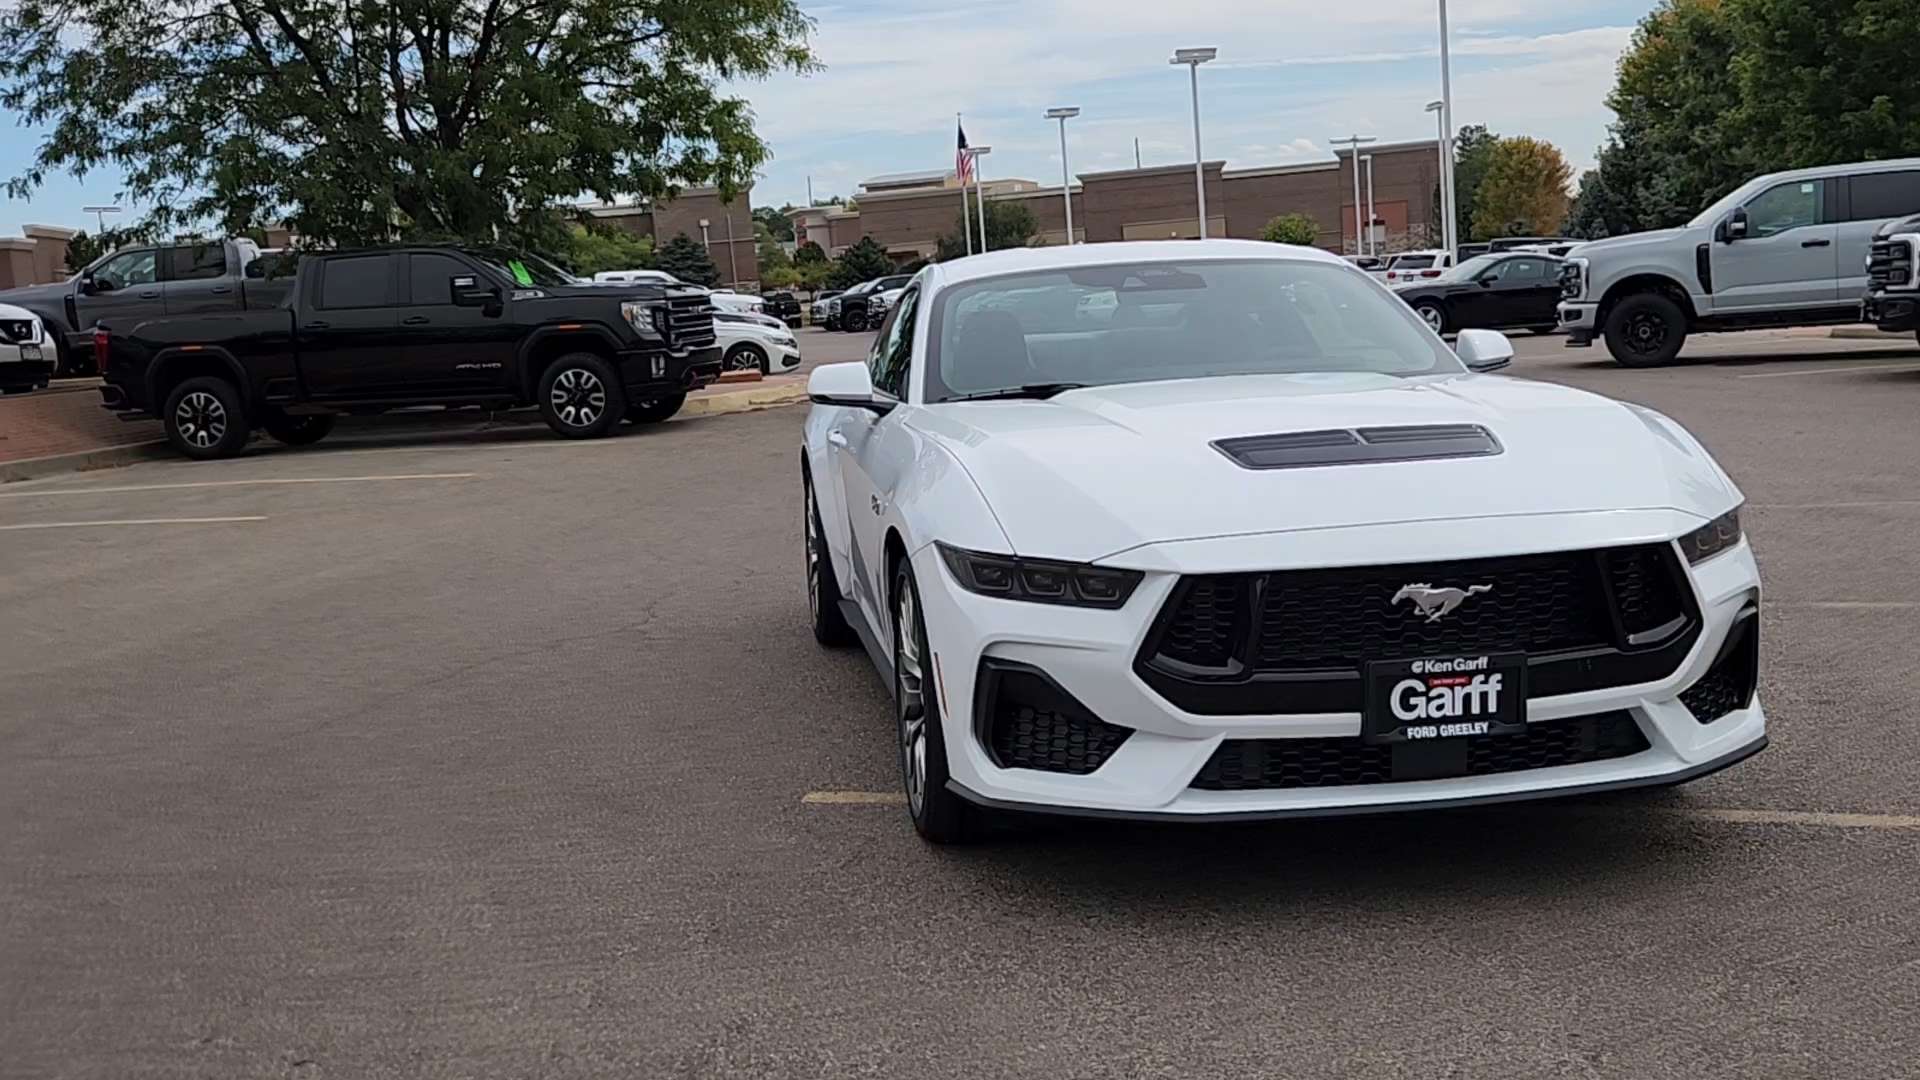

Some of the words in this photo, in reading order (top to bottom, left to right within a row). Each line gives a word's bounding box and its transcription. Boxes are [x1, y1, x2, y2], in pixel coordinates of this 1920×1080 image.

[1424, 659, 1452, 673] Ken
[1453, 656, 1489, 671] Garff
[1390, 673, 1502, 721] Garff
[1407, 726, 1437, 739] FORD
[1439, 722, 1489, 737] GREELEY
